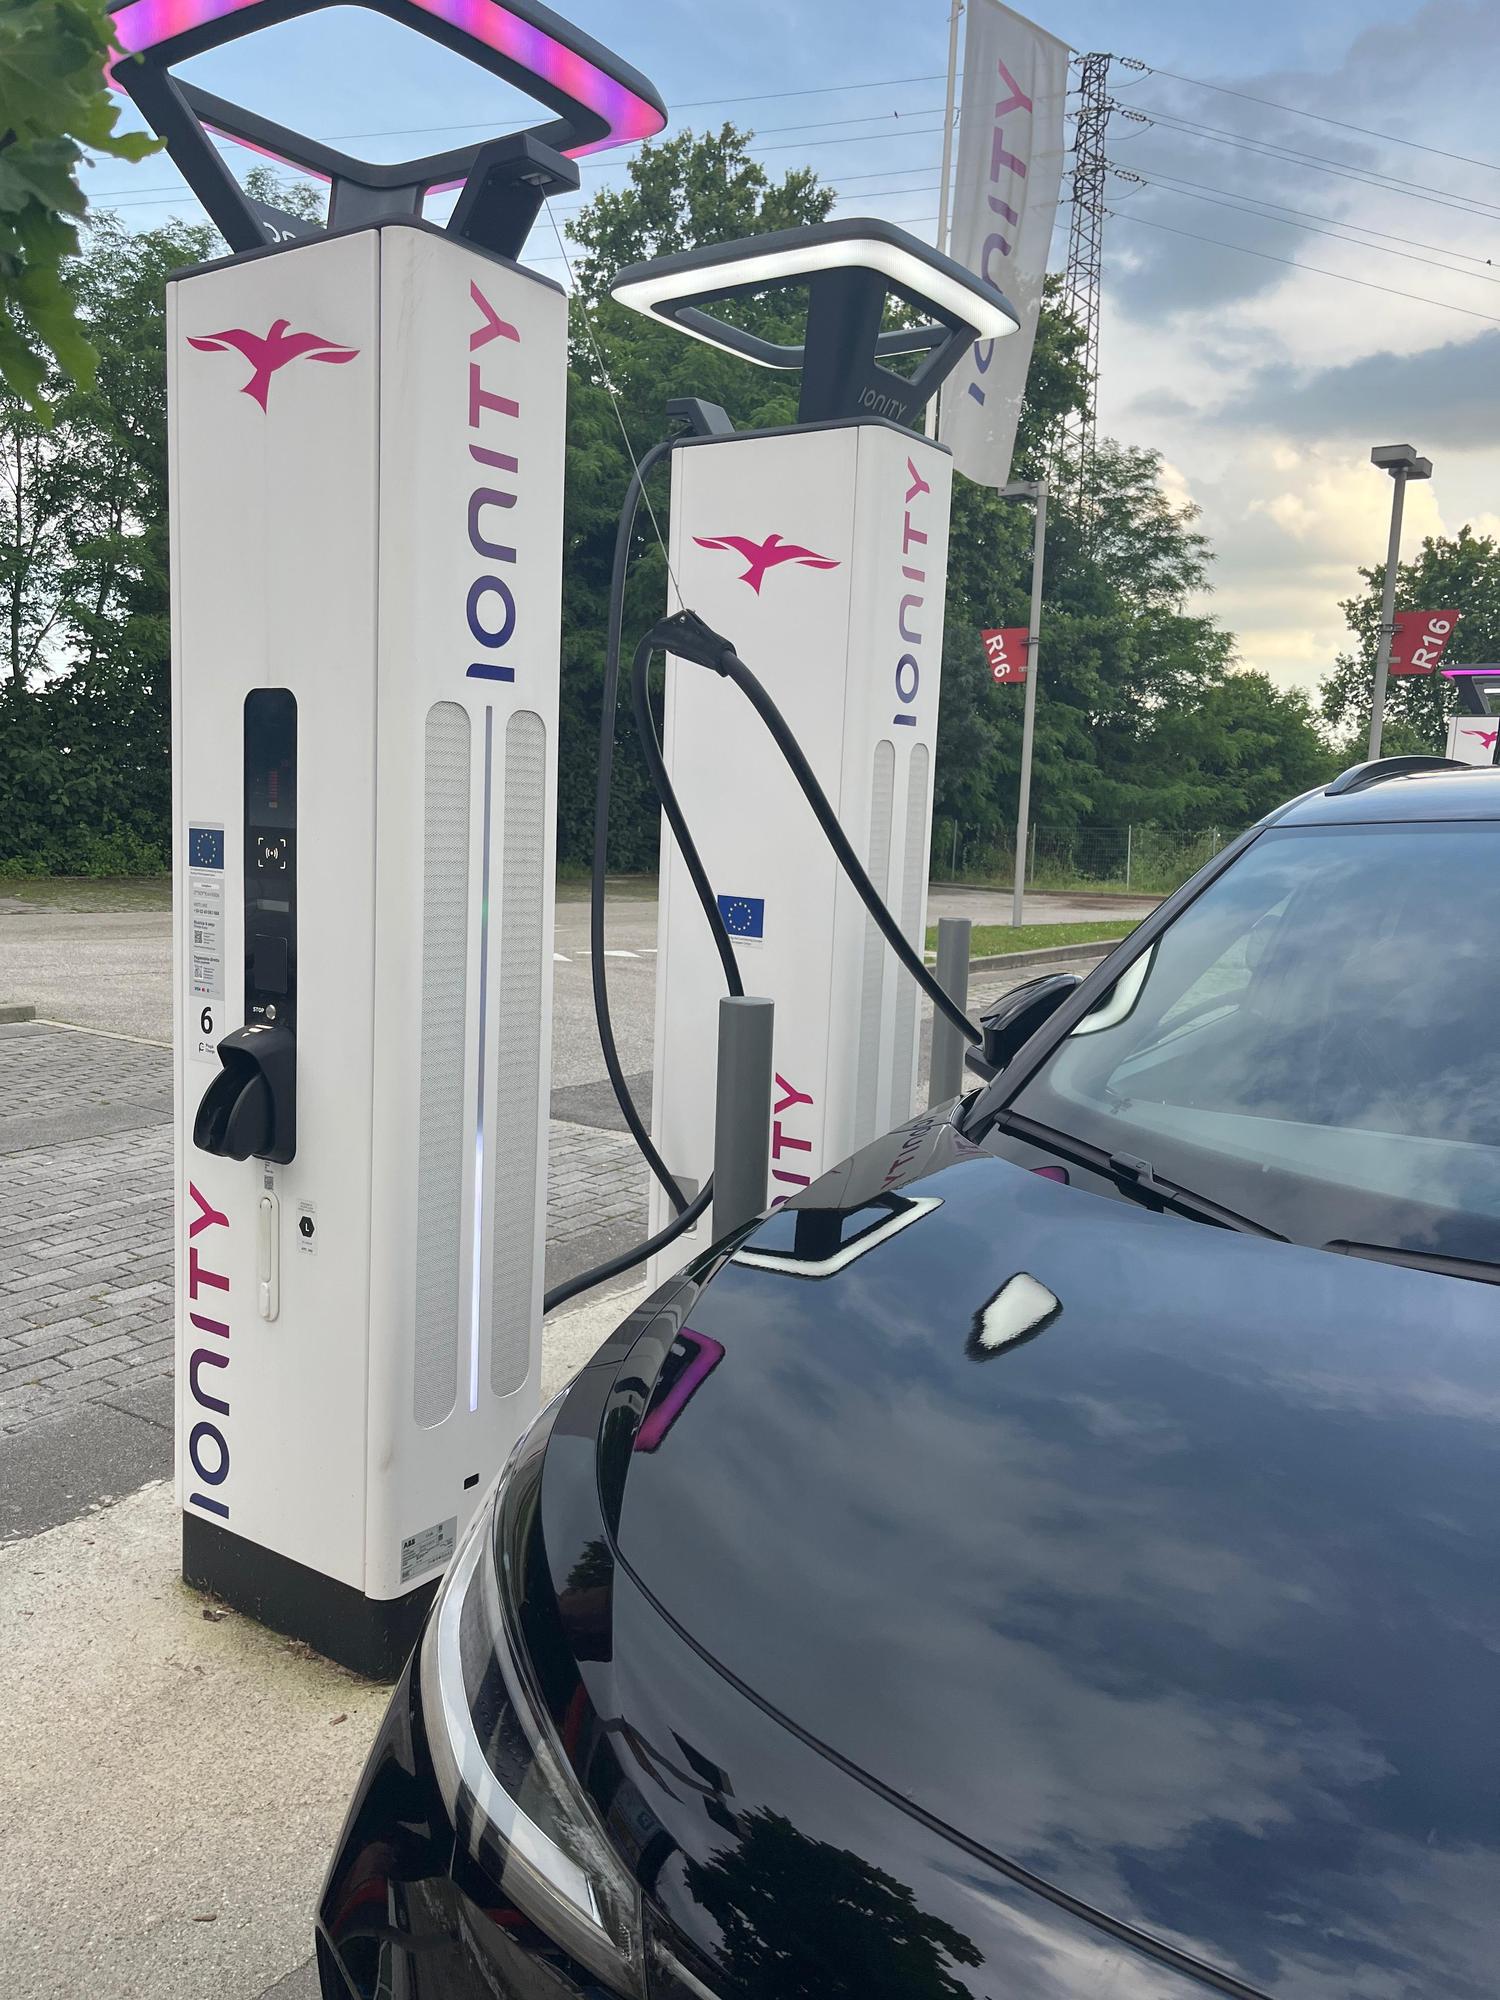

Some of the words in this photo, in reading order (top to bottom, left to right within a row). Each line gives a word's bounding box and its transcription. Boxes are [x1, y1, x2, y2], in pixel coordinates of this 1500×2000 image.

[857, 386, 908, 421] IONITY
[465, 279, 521, 684] IONITY
[892, 455, 931, 727] IONITY
[985, 634, 1011, 678] R16
[1410, 617, 1451, 670] R16
[200, 1006, 214, 1035] 6
[251, 1006, 265, 1014] STOP
[189, 1180, 230, 1520] IONITY
